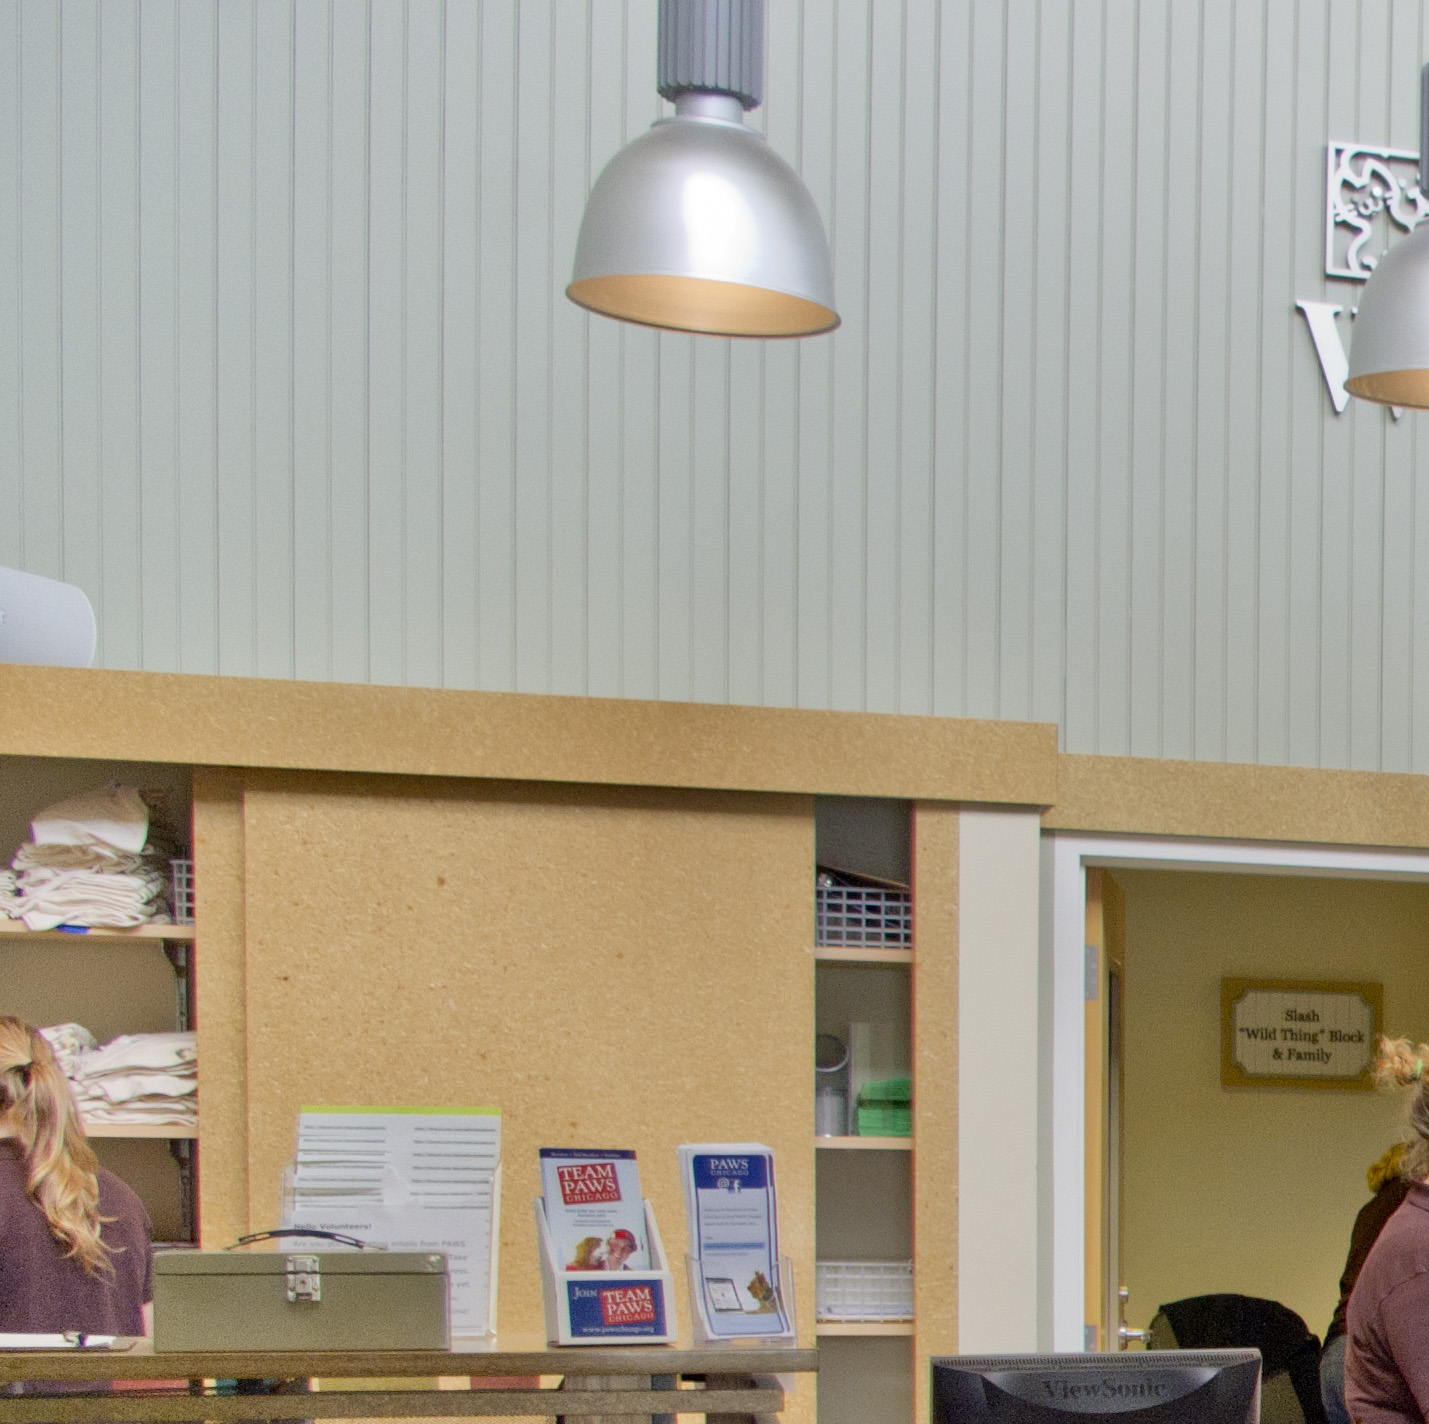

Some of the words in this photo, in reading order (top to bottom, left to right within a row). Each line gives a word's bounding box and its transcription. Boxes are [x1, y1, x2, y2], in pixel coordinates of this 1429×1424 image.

[1284, 1009, 1320, 1022] Slash
[1329, 1030, 1365, 1043] Block
[1272, 1048, 1283, 1061] &
[1287, 1048, 1332, 1064] Family
[710, 1158, 750, 1169] PAWS
[558, 1164, 615, 1181] TEAM
[563, 1178, 616, 1195] PAWS
[566, 1191, 618, 1203] CHICAGO
[602, 1288, 652, 1303] TEAM
[607, 1301, 654, 1316] PAWS
